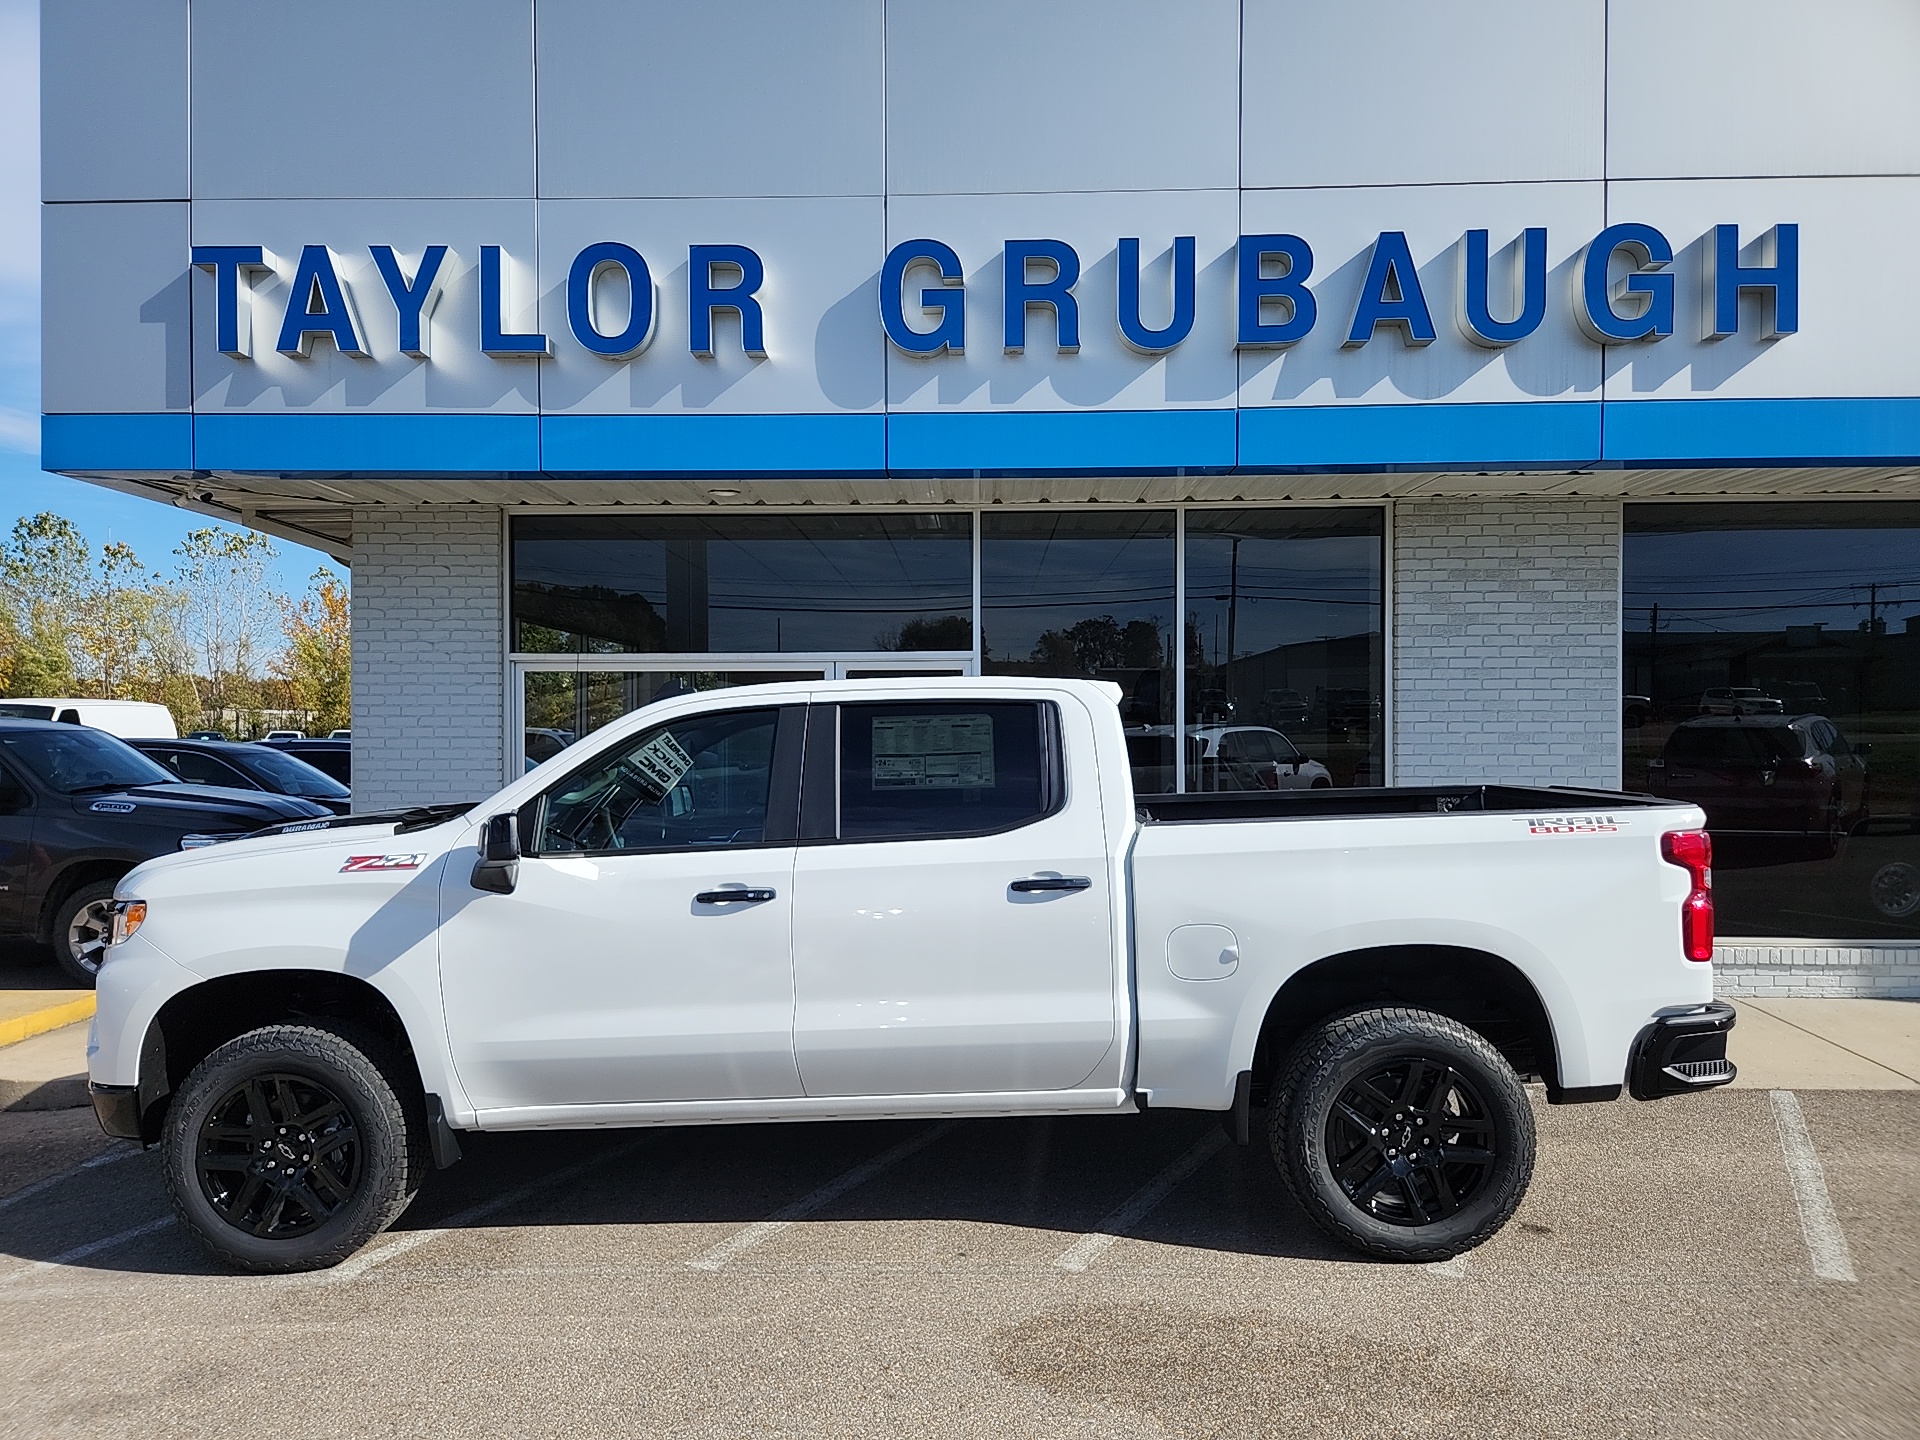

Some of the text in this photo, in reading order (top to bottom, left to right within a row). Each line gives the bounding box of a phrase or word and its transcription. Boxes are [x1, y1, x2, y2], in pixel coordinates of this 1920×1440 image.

[191, 223, 1800, 360] TAYLOR GRUBAUGH
[281, 821, 331, 834] DURAMAX
[1511, 815, 1631, 827] TRAIL
[1529, 825, 1619, 834] BOSS
[338, 852, 429, 874] Z71
